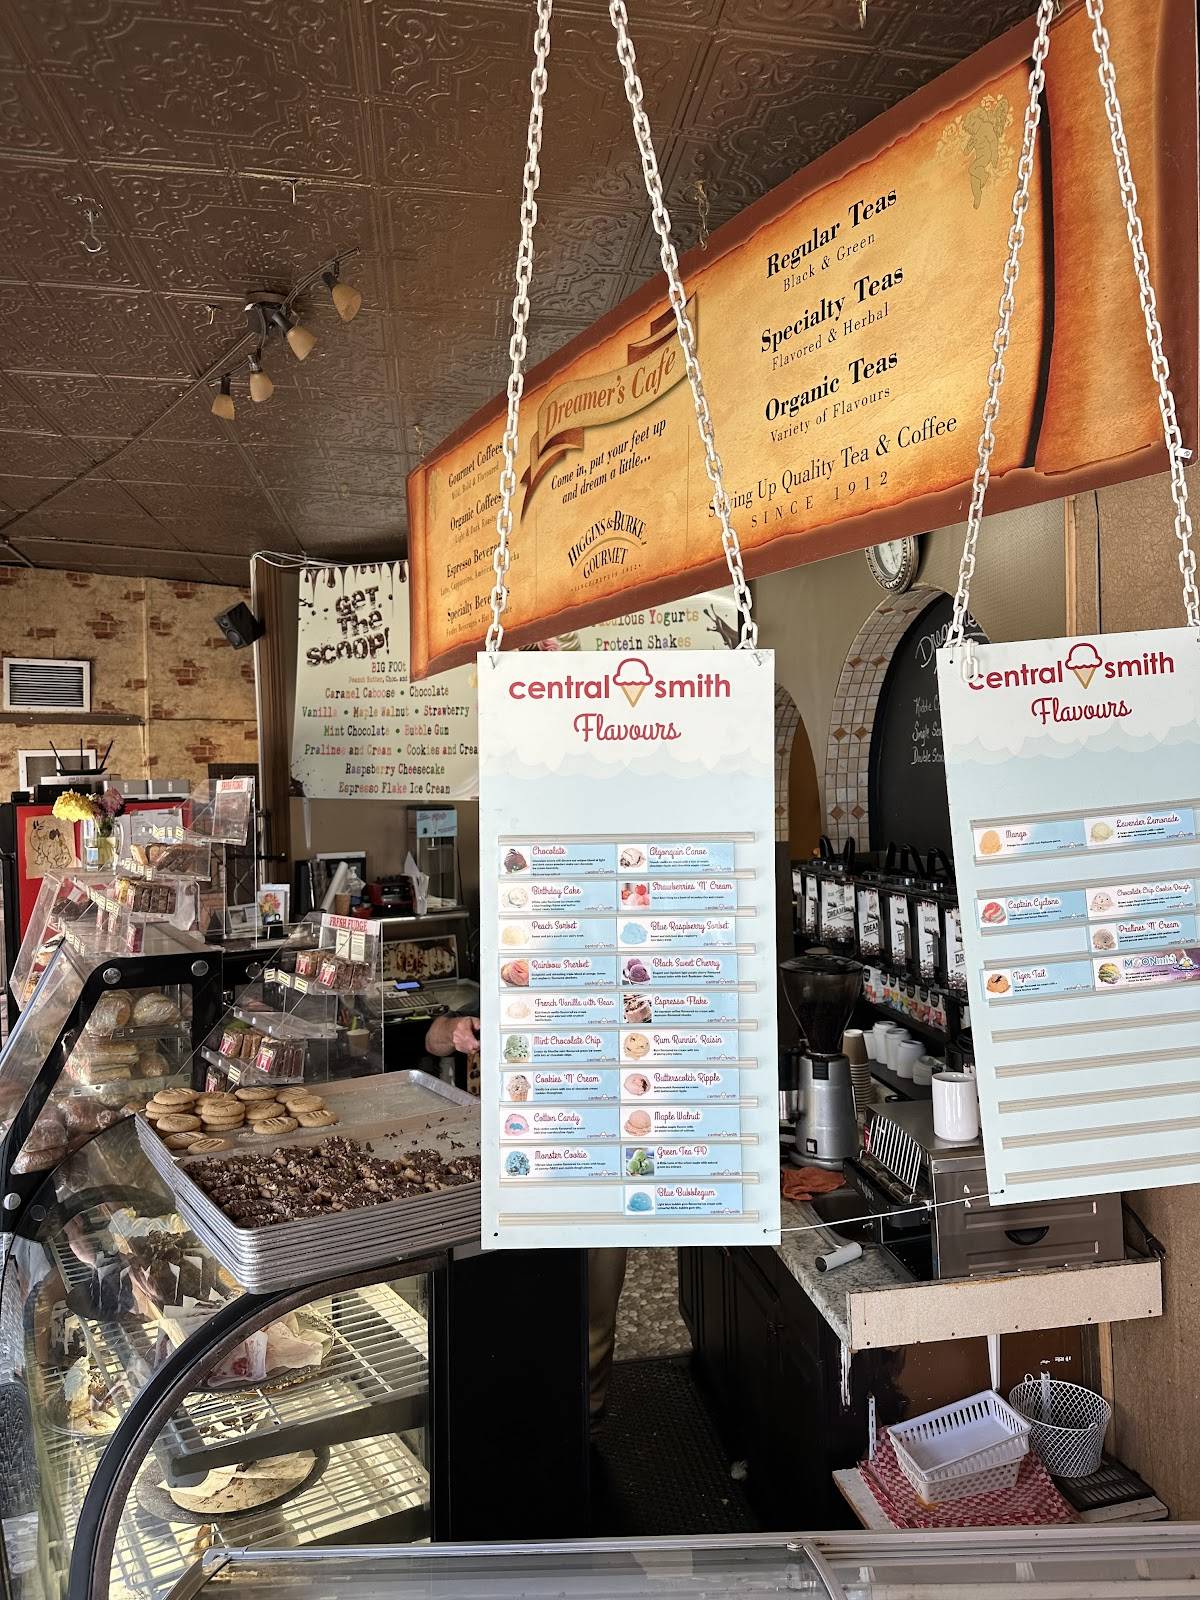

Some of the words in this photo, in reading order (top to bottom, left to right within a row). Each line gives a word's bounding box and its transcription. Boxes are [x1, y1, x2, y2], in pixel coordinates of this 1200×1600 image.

[766, 221, 840, 278] Regular
[848, 188, 897, 228] Teas
[783, 267, 816, 292] Black
[821, 256, 831, 270] &
[836, 234, 876, 261] Green
[761, 296, 846, 353] Specialty
[853, 267, 904, 304] Teas
[771, 335, 822, 371] Flavored
[828, 329, 838, 343] &
[843, 302, 890, 337] Herbal
[765, 374, 840, 421] Organic
[849, 351, 899, 385] Teas
[544, 375, 625, 440] Dreamer's
[770, 420, 810, 444] Variety
[816, 409, 827, 425] of
[833, 387, 891, 419] Flavours
[551, 470, 574, 490] Come
[576, 464, 588, 476] in,
[589, 453, 605, 475] put
[607, 440, 629, 465] your
[629, 428, 650, 452] feet
[653, 419, 667, 437] up
[758, 478, 777, 501] Up
[782, 454, 836, 488] Quality
[840, 446, 870, 469] Tea
[875, 434, 890, 457] &
[898, 415, 958, 449] Coffee
[448, 460, 475, 487] Gourmet
[562, 483, 578, 504] and
[580, 472, 607, 495] dream
[610, 469, 616, 480] a
[751, 495, 814, 528] SINCE
[833, 470, 889, 501] 1912
[450, 507, 474, 531] Organic
[447, 557, 472, 578] Espresso
[583, 546, 628, 579] GOURMET
[448, 600, 473, 624] Specialty
[649, 608, 699, 627] Yogurts
[596, 636, 643, 651] Protein
[647, 634, 692, 649] Shakes
[372, 662, 386, 673] BIG
[968, 660, 1063, 690] central
[1104, 652, 1175, 679] smith
[325, 687, 361, 700] Caramel
[363, 687, 395, 699] Caboose
[409, 685, 449, 698] Chocolate
[508, 674, 610, 699] central
[654, 673, 731, 698] smith
[302, 706, 338, 718] Vanilla
[353, 707, 379, 721] Maple
[381, 705, 409, 717] Walnut
[423, 705, 470, 718] Strawberry
[1031, 697, 1132, 725] Flavours
[324, 725, 344, 736] Mint
[347, 724, 390, 736] Chocolate
[404, 724, 432, 736] Bubble
[434, 724, 450, 736] Gum
[573, 713, 682, 742] Flavours
[304, 744, 346, 756] Pralines
[348, 744, 365, 756] and
[367, 744, 392, 756] Cream
[407, 744, 440, 755] Cookies
[442, 744, 457, 755] and
[459, 744, 478, 755] Crea
[398, 762, 445, 775] Cheesecake
[339, 782, 378, 796] Espresso
[381, 782, 408, 794] Flake
[410, 782, 423, 794] Ice
[425, 782, 451, 794] Cream
[1147, 813, 1180, 825] Lemonade
[1005, 830, 1027, 840] Mango
[532, 845, 566, 856] Chocolate
[531, 885, 562, 898] Birthday
[563, 885, 582, 895] Cake
[652, 881, 695, 891] Strawberries
[709, 881, 733, 890] Cream
[1007, 900, 1033, 910] Captain
[1033, 897, 1060, 910] Cyclone
[329, 916, 346, 928] FRESH
[347, 919, 368, 932] FUDGE
[531, 920, 554, 930] Peach
[554, 920, 578, 930] Sorbet
[650, 921, 668, 931] Blue
[668, 921, 706, 934] Raspberry
[706, 920, 730, 930] Sorbet
[1158, 920, 1180, 930] Cream
[531, 960, 561, 970] Rainbow
[563, 959, 590, 969] Sherbet
[652, 957, 674, 968] Black
[675, 957, 695, 967] Sweet
[696, 957, 721, 971] Cherry
[534, 998, 557, 1007] French
[559, 998, 581, 1007] Vanilla
[583, 998, 596, 1006] with
[598, 998, 614, 1006] Bean
[654, 996, 685, 1008] Espresso
[686, 996, 708, 1005] Flake
[533, 1036, 548, 1045] Mint
[550, 1035, 584, 1045] Chocolate
[585, 1035, 602, 1047] Chip
[653, 1034, 671, 1045] Rum
[700, 1034, 723, 1045] Raisin
[535, 1074, 562, 1083] Cookies
[576, 1073, 600, 1083] Cream
[653, 1073, 697, 1082] Butterscotch
[697, 1072, 721, 1085] Ripple
[533, 1112, 556, 1122] Cotton
[557, 1112, 581, 1125] Candy
[654, 1111, 676, 1124] Maple
[676, 1111, 701, 1121] Walnut
[534, 1149, 562, 1160] Monster
[563, 1149, 588, 1159] Cookie
[656, 1146, 678, 1158] Green
[679, 1146, 692, 1155] Tea
[657, 1187, 675, 1197] Blue
[675, 1187, 716, 1201] Bubblegum
